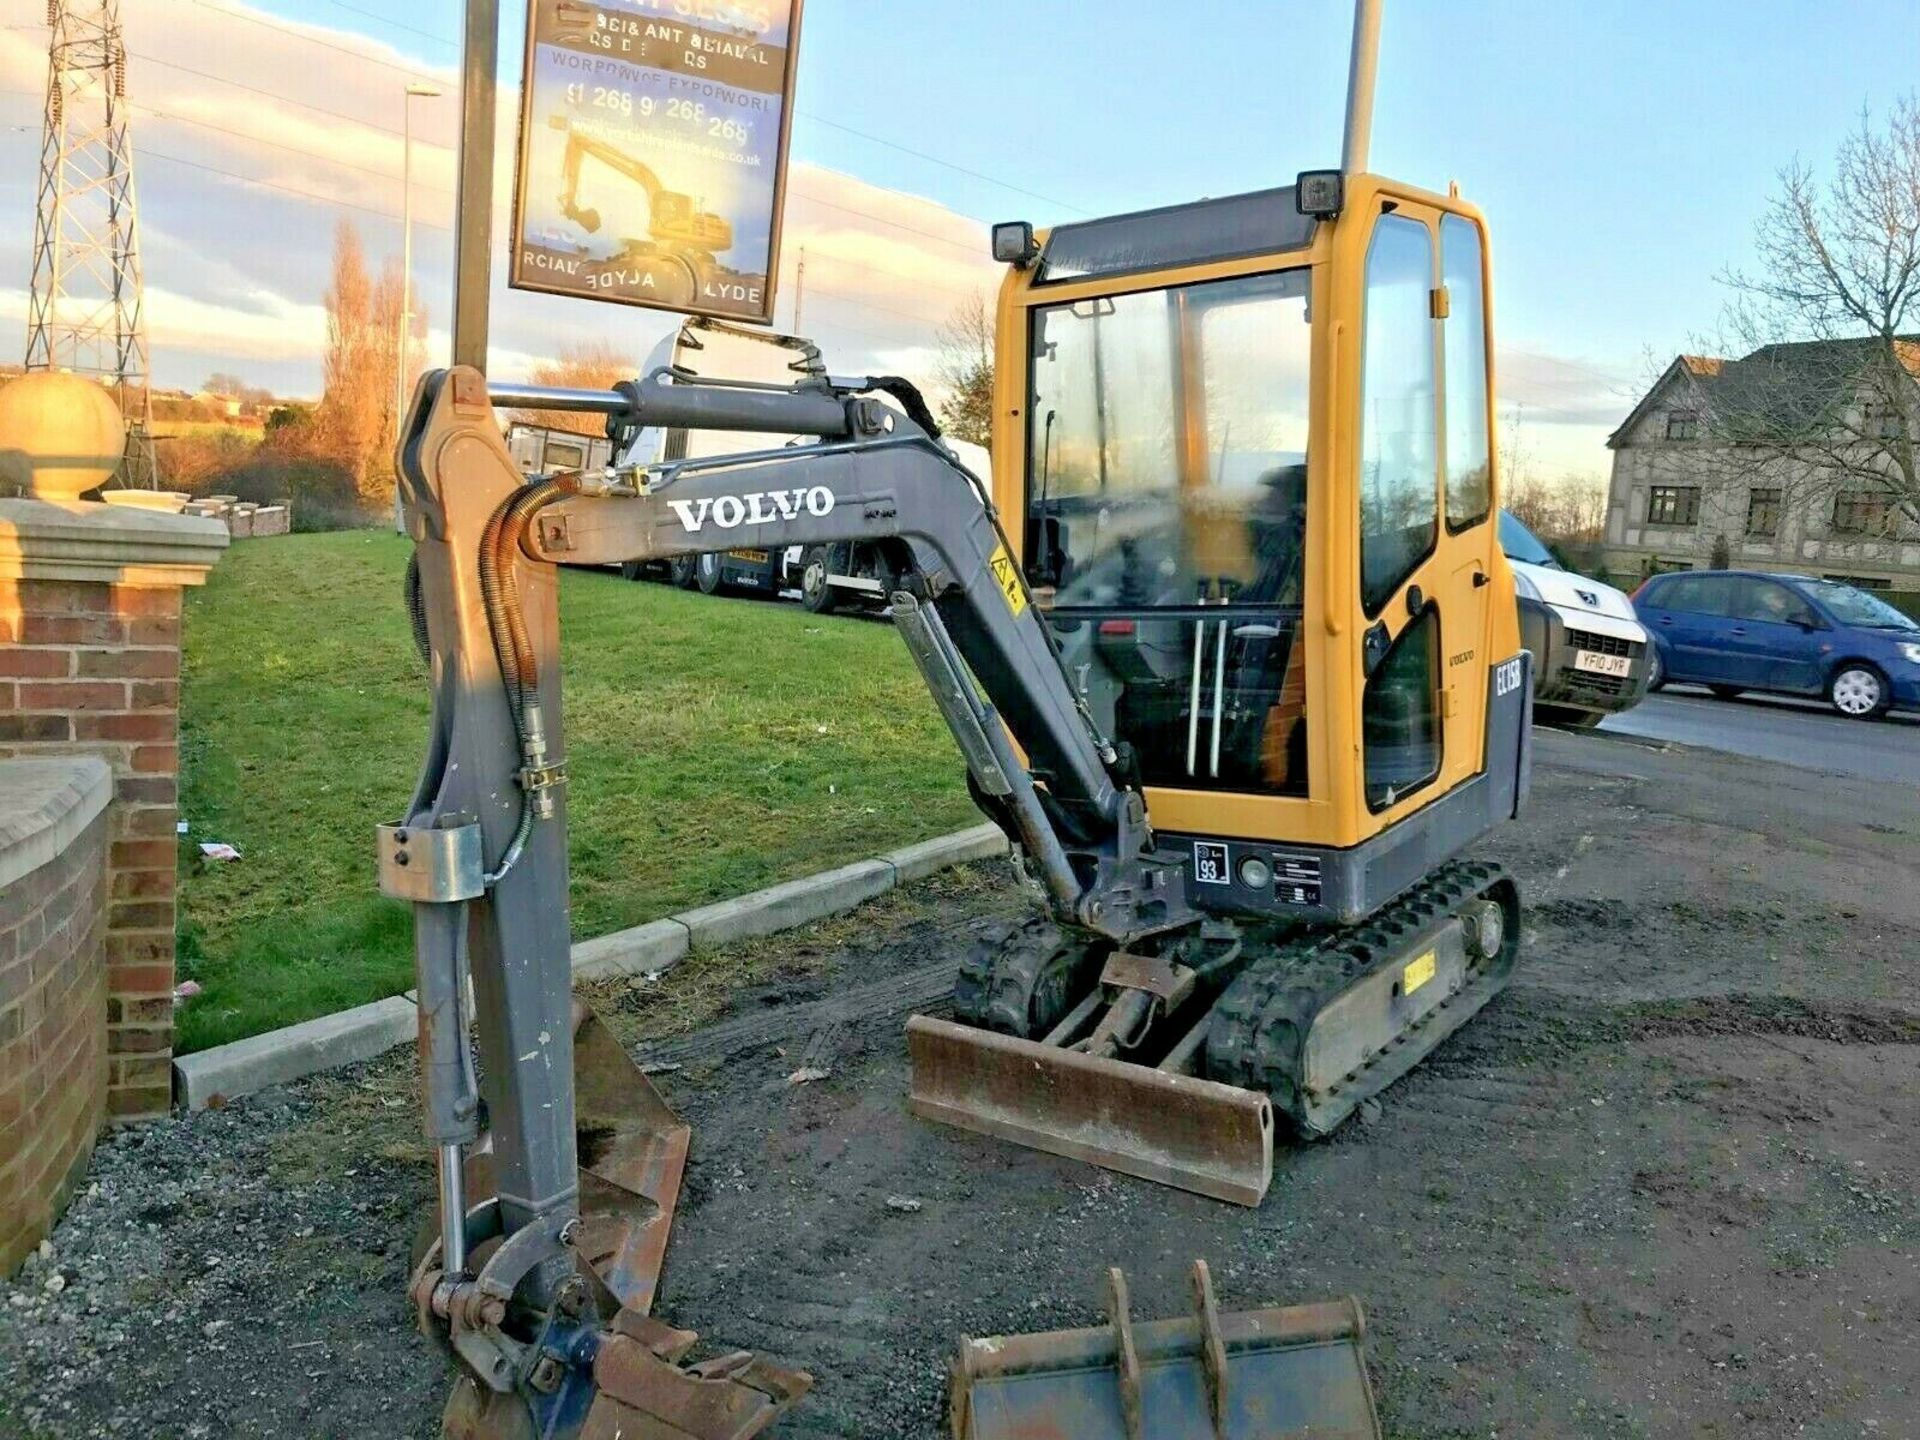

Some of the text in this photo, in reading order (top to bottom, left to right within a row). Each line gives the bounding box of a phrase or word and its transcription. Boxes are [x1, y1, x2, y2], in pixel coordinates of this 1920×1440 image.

[667, 486, 835, 532] VOLVO
[1449, 650, 1475, 667] VOLVO
[1583, 652, 1606, 669] YF10
[1200, 860, 1217, 880] 93
